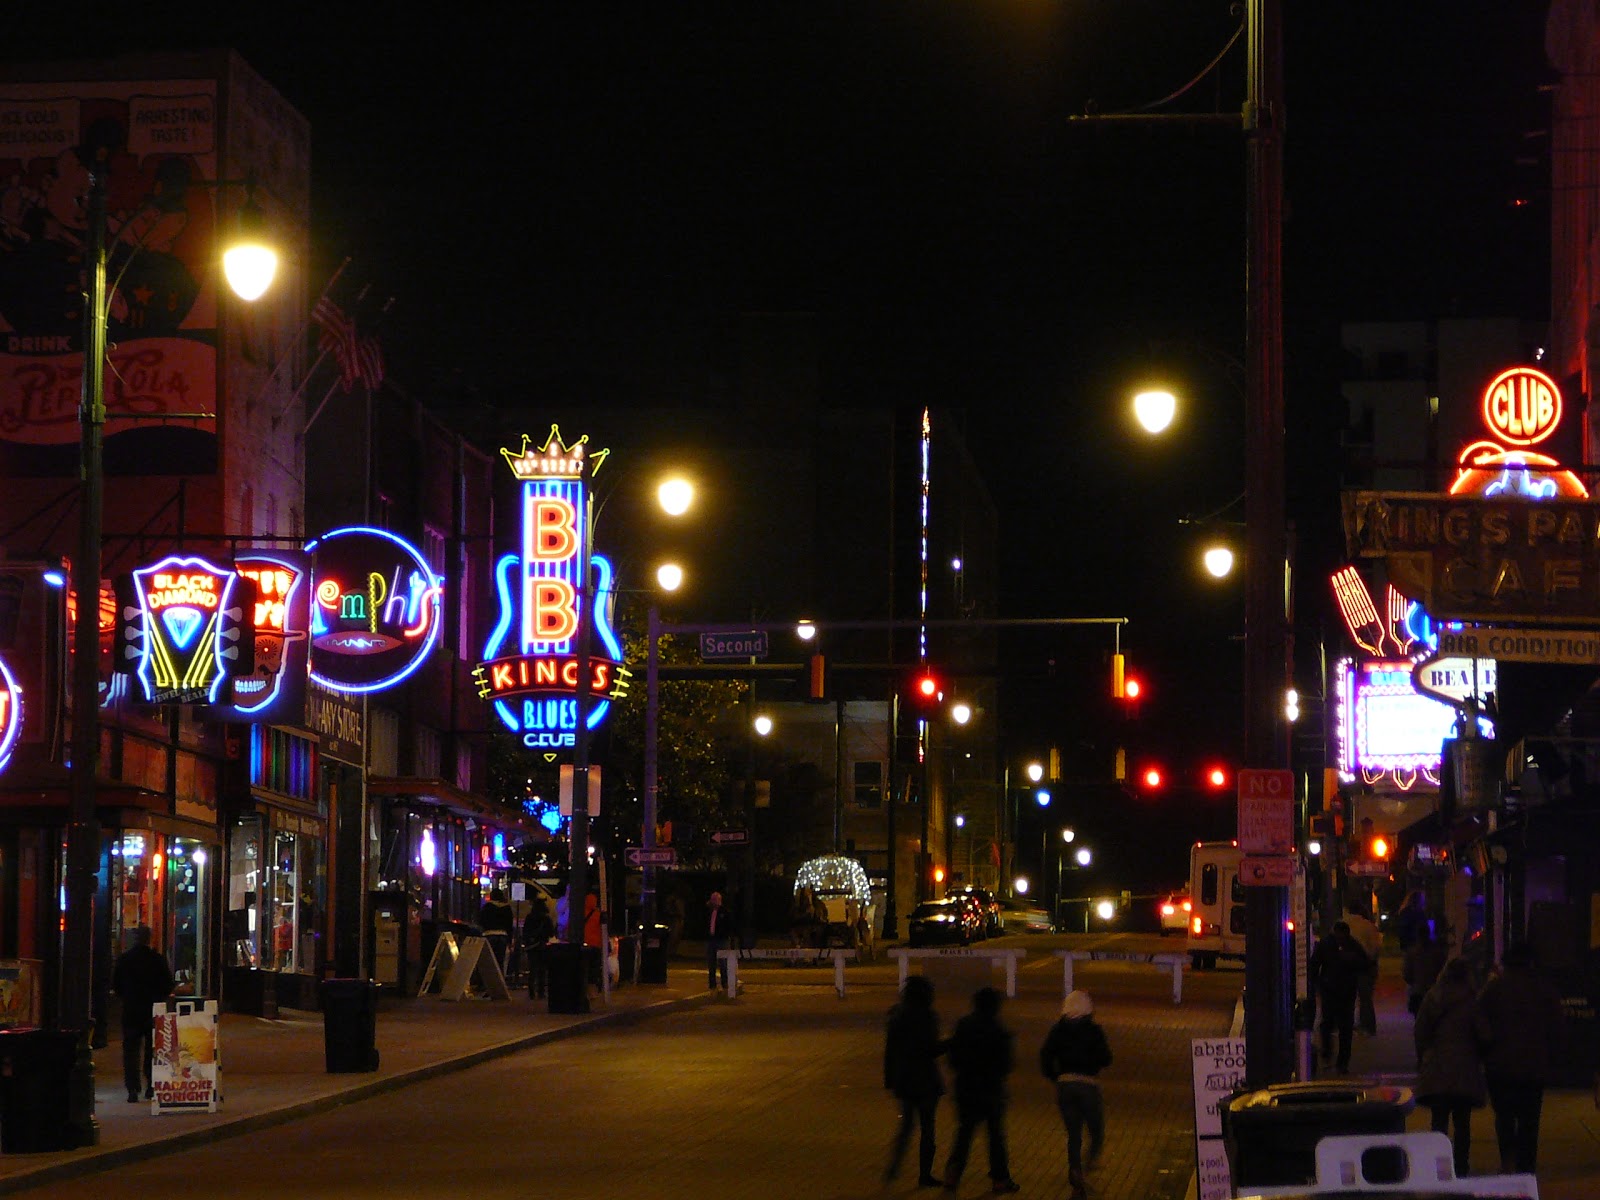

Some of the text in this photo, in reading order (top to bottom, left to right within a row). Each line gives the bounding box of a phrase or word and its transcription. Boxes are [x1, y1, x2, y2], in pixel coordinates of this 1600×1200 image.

[8, 335, 72, 351] DRINK
[1492, 376, 1553, 436] CLUB
[154, 574, 214, 589] BLACK
[1441, 556, 1586, 604] CAF
[147, 588, 218, 609] DIAMOND
[705, 637, 763, 654] Second
[1444, 634, 1479, 654] AIR
[1431, 669, 1497, 686] BEAE
[523, 700, 578, 730] BLUES
[1249, 775, 1282, 793] NO
[1194, 1041, 1246, 1057] absin
[1214, 1056, 1246, 1069] roo
[154, 1079, 212, 1091] KARAOKE
[156, 1090, 210, 1102] TONIGHT
